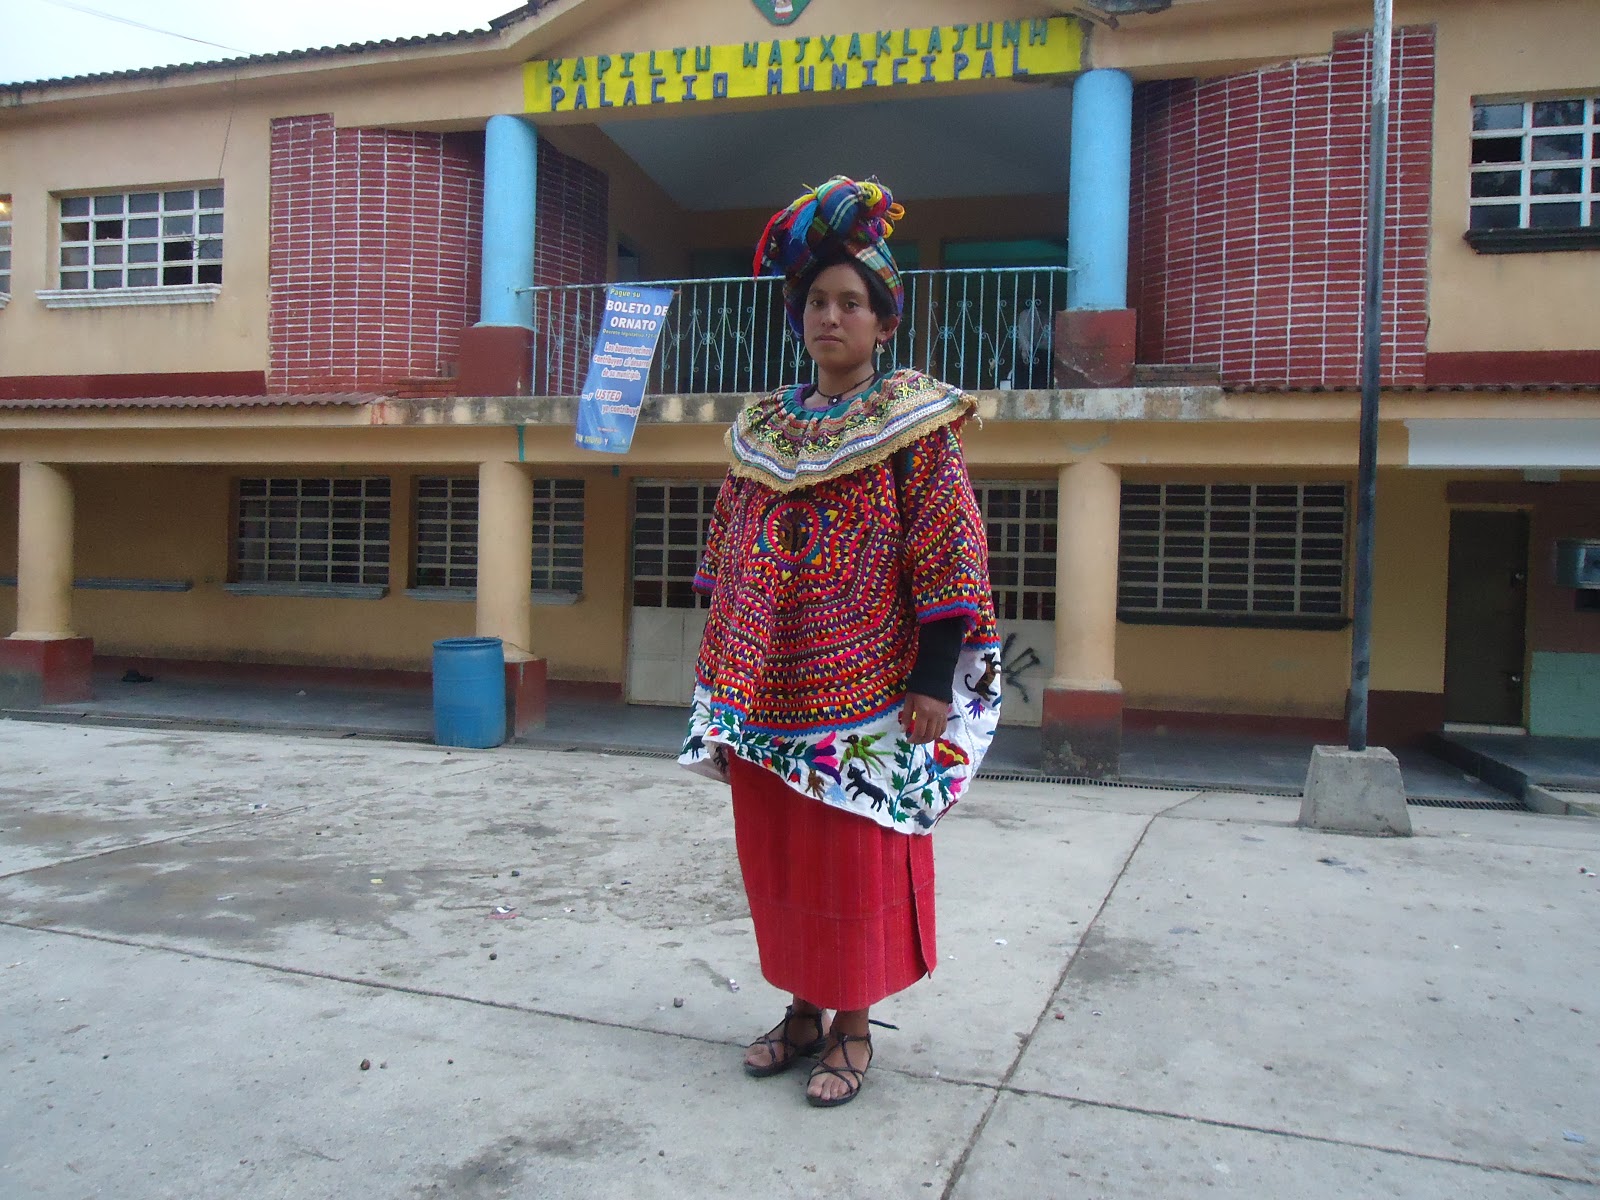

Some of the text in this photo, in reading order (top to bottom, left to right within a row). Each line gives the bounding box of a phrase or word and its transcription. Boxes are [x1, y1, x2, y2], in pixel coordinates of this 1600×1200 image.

[547, 17, 1048, 84] KAPILTU WAJXAKLAJUNH
[551, 46, 1029, 112] PALACIO MUNICIPAL
[610, 288, 631, 298] Pague
[606, 300, 669, 316] BOLETO DE
[610, 316, 657, 331] ORNATO
[595, 389, 622, 402] USTED
